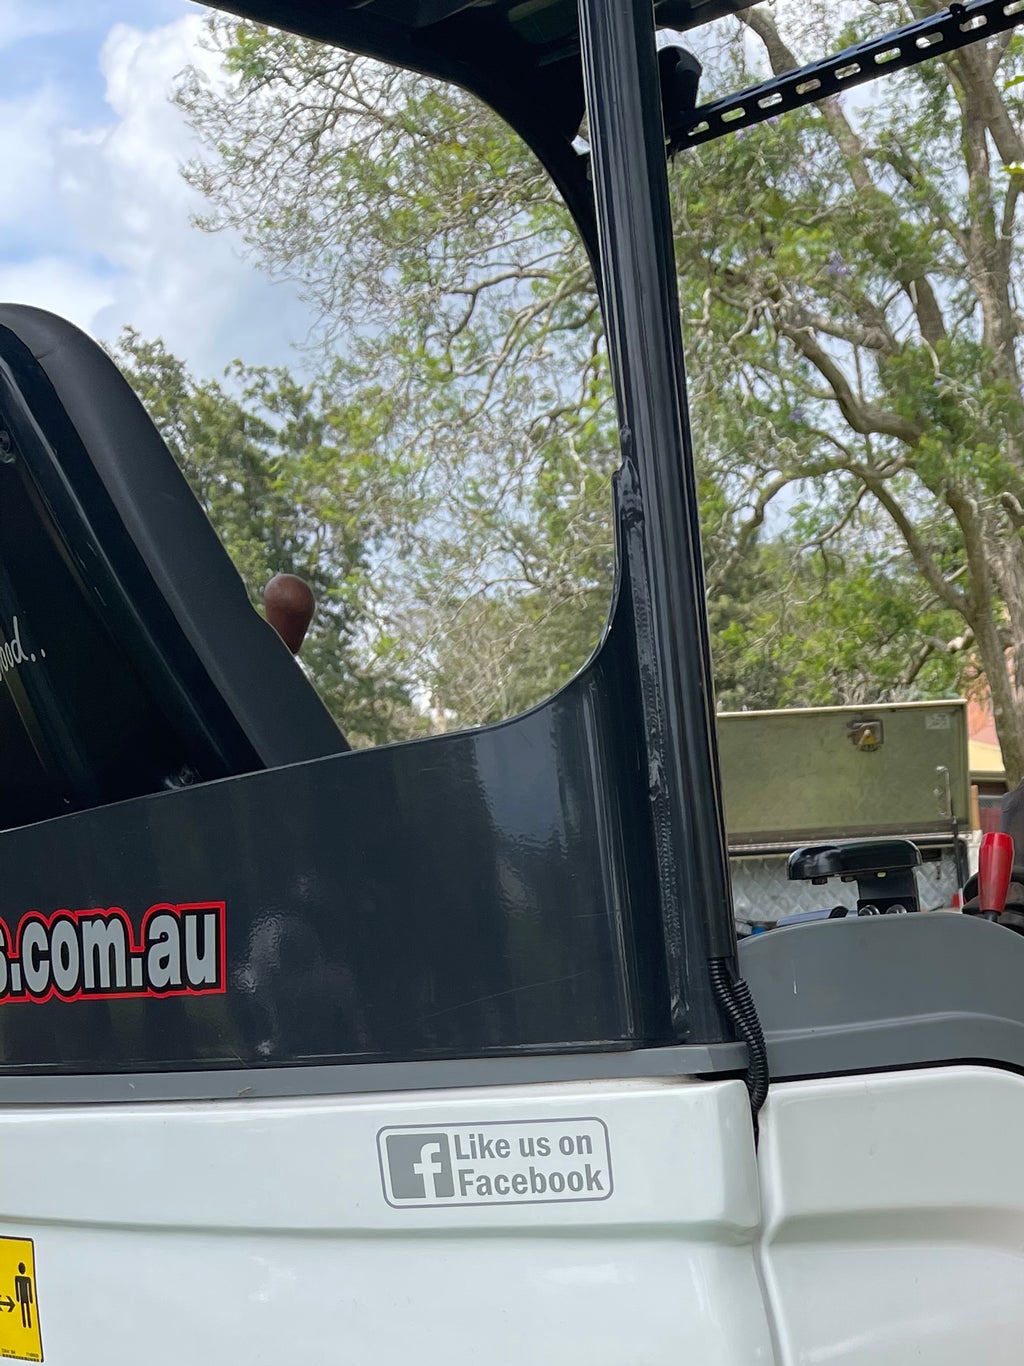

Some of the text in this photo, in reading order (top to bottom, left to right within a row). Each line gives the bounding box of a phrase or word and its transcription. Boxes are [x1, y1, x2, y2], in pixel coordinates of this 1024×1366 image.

[454, 1133, 593, 1160] Like us on
[458, 1164, 605, 1197] Facebook
